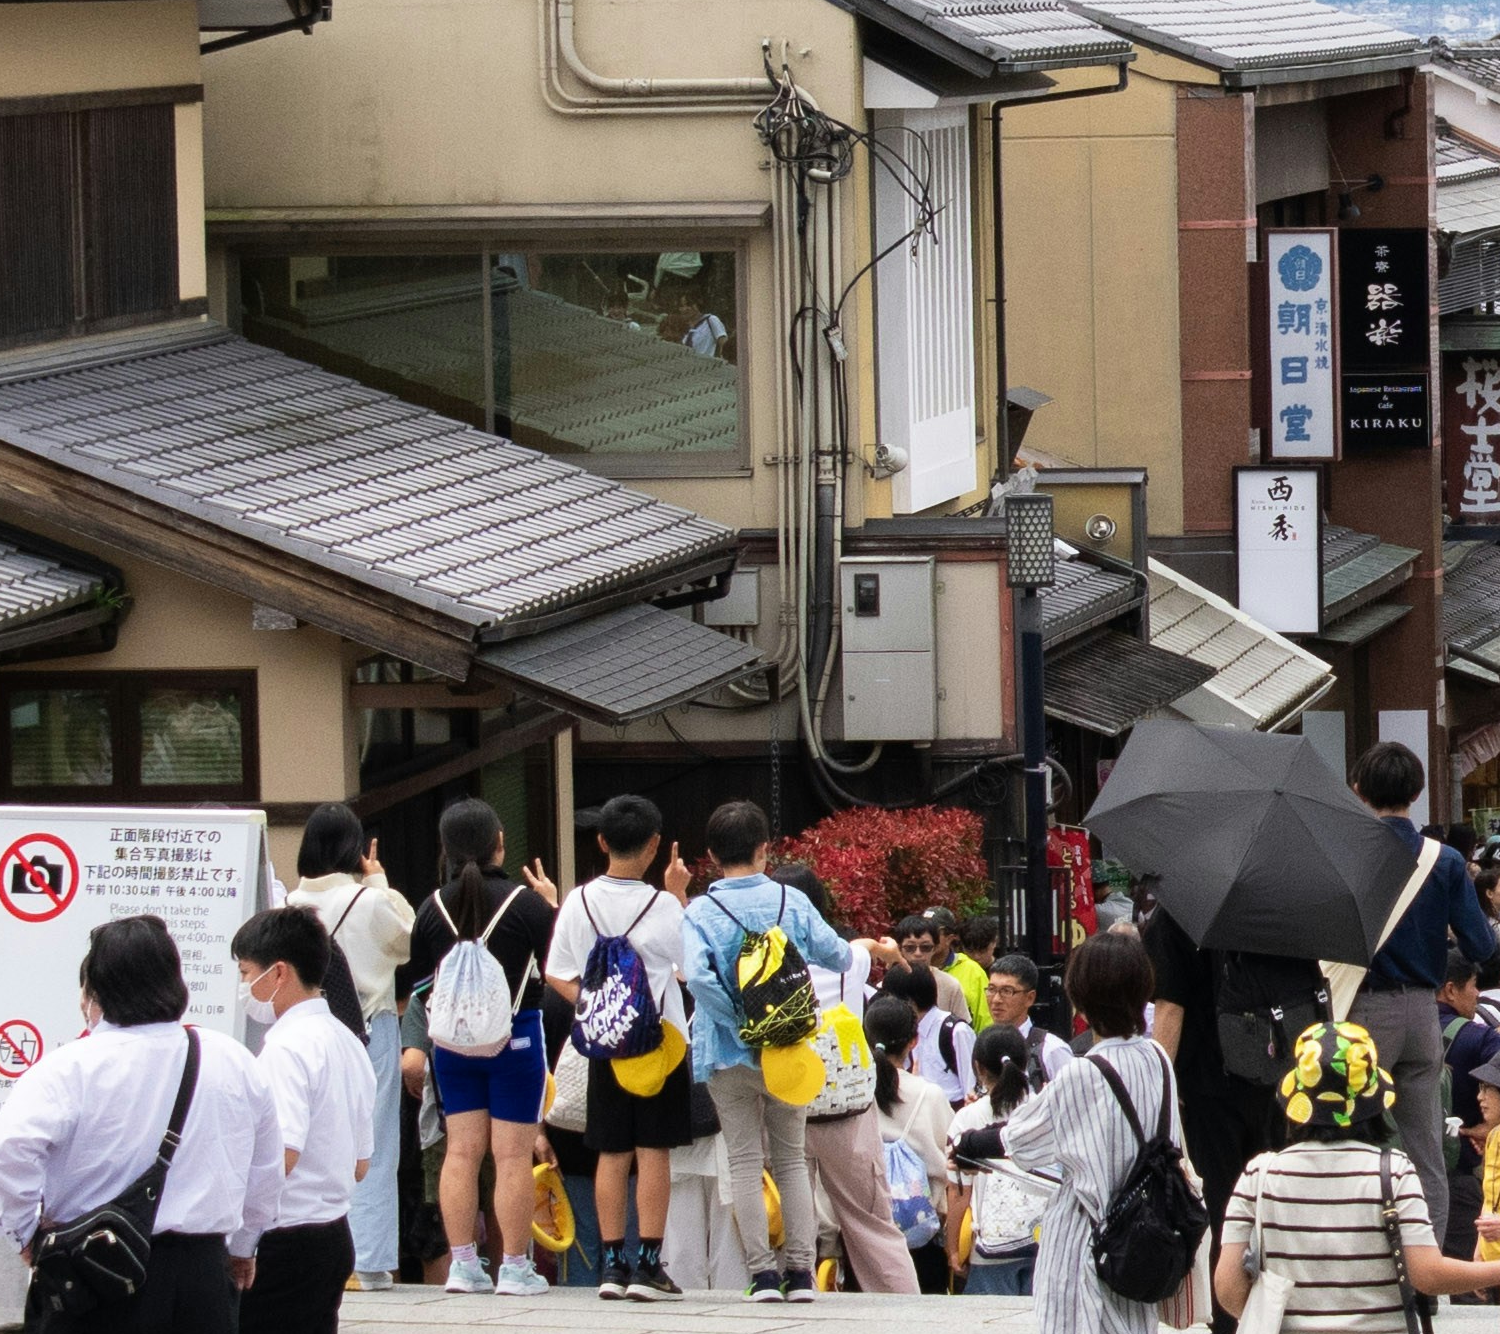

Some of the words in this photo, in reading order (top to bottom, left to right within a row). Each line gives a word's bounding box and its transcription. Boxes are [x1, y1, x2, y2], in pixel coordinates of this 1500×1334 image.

[1277, 300, 1313, 442] 朝日堂
[1383, 385, 1422, 394] Restaurant
[1350, 418, 1422, 429] KIRAKU
[1267, 475, 1294, 542] 西秀
[110, 827, 222, 844] 正面階段付近での
[114, 845, 213, 863] 集合写真撮影は
[84, 864, 243, 883] 下記の時間撮影禁止です。
[110, 903, 140, 915] Please
[142, 903, 168, 916] don't
[170, 904, 191, 916] take
[193, 905, 209, 917] the
